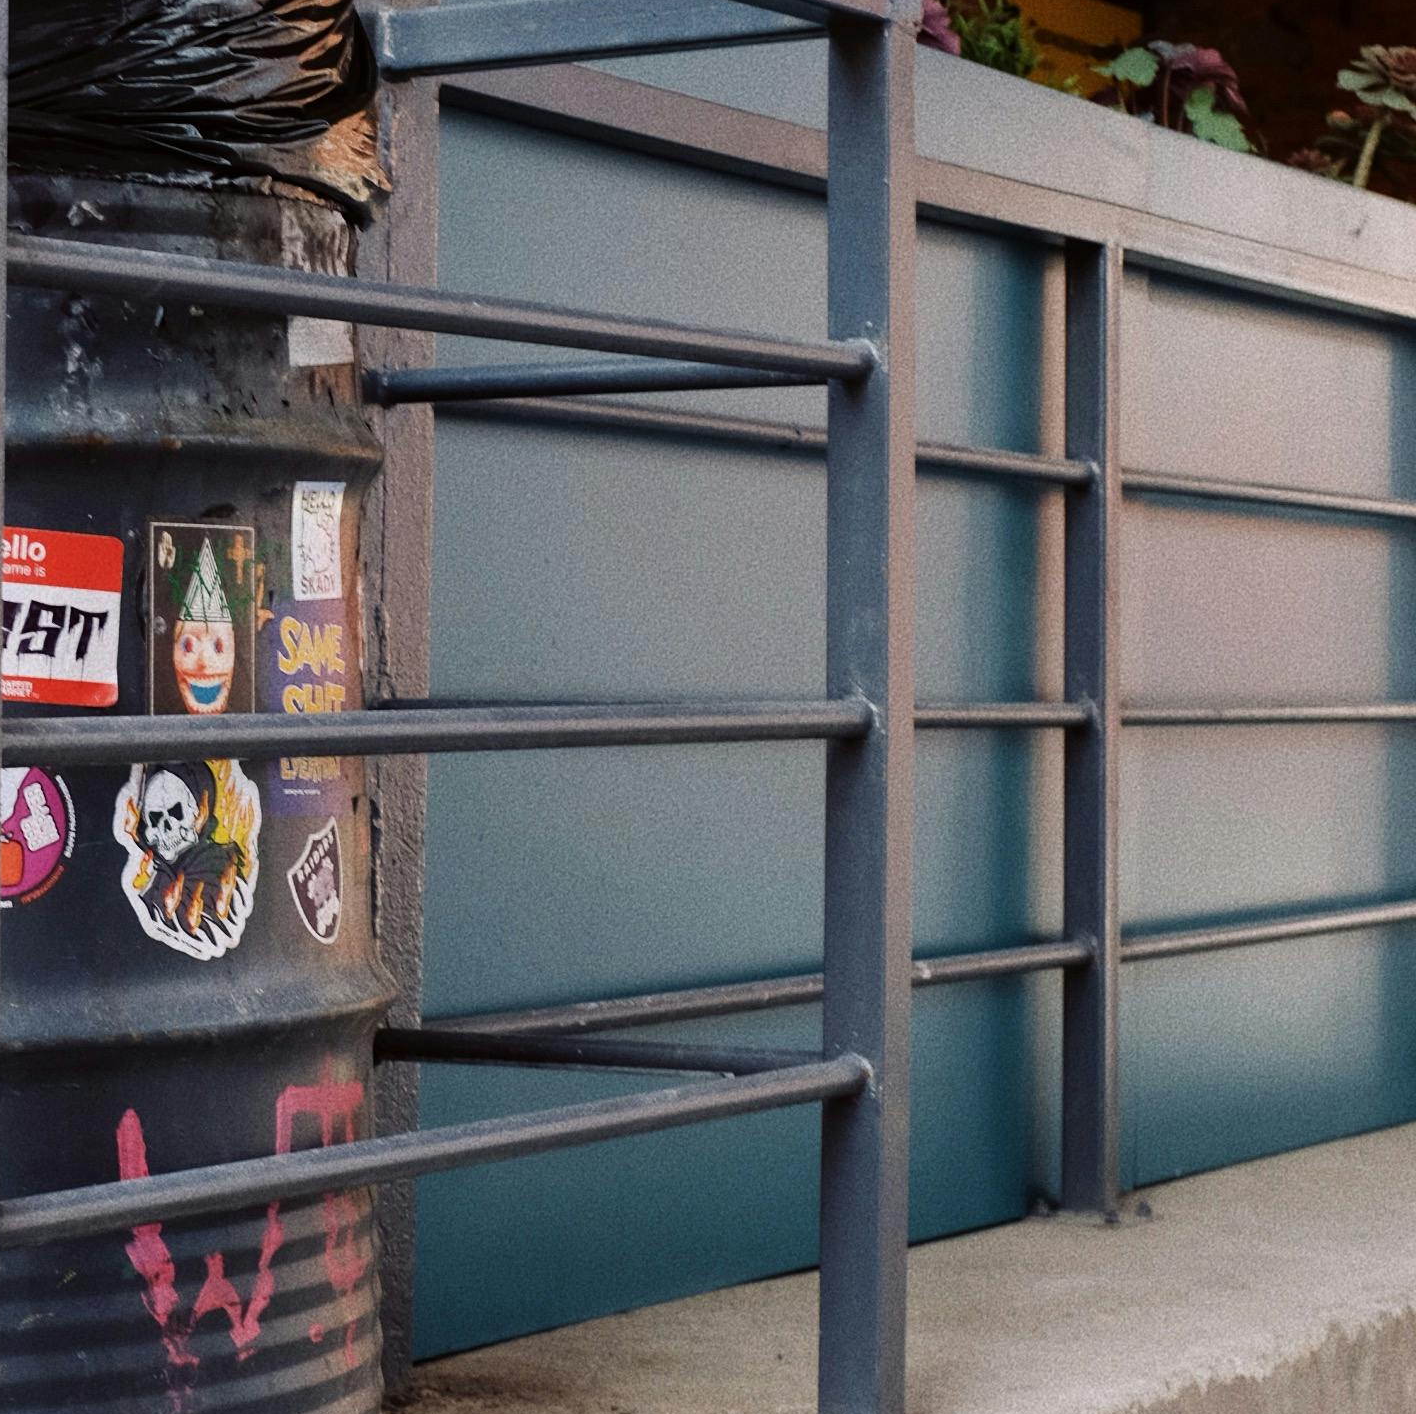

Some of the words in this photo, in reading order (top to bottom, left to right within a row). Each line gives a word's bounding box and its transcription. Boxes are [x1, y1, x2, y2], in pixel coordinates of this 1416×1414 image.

[1, 533, 47, 563] ello
[2, 563, 32, 576] ame
[34, 566, 47, 578] is
[276, 615, 346, 677] SAME
[296, 830, 334, 884] RAIDERS
